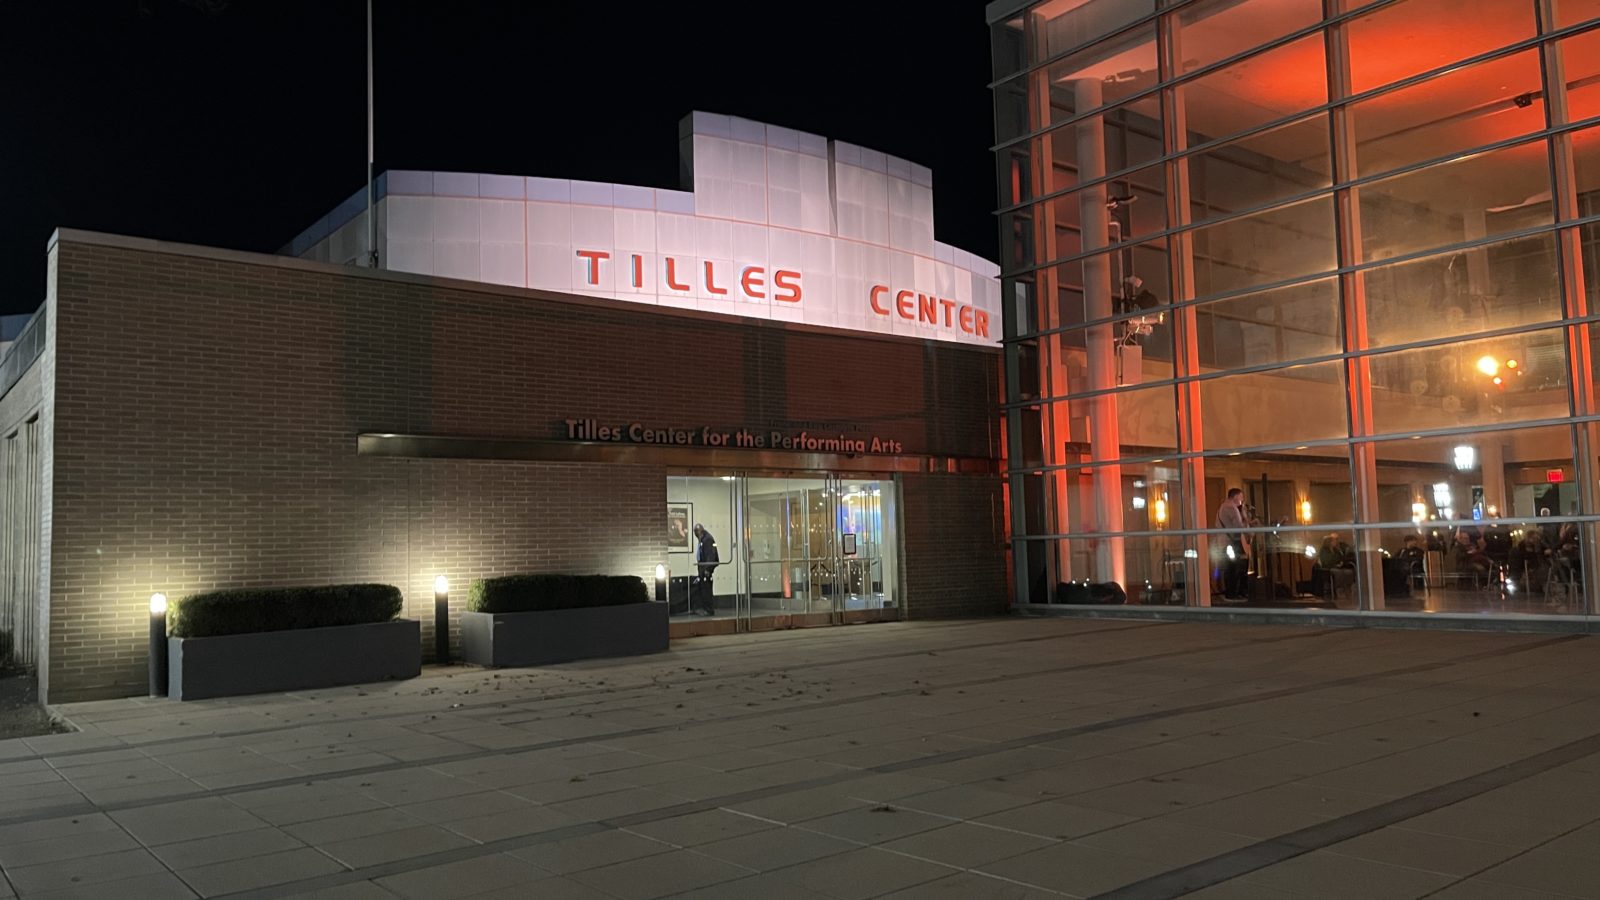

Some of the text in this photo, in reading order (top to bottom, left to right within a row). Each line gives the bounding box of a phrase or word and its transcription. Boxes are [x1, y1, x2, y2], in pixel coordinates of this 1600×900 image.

[577, 251, 990, 337] TILLES CENTER
[566, 419, 903, 453] Tilles Center for the Performing Arts
